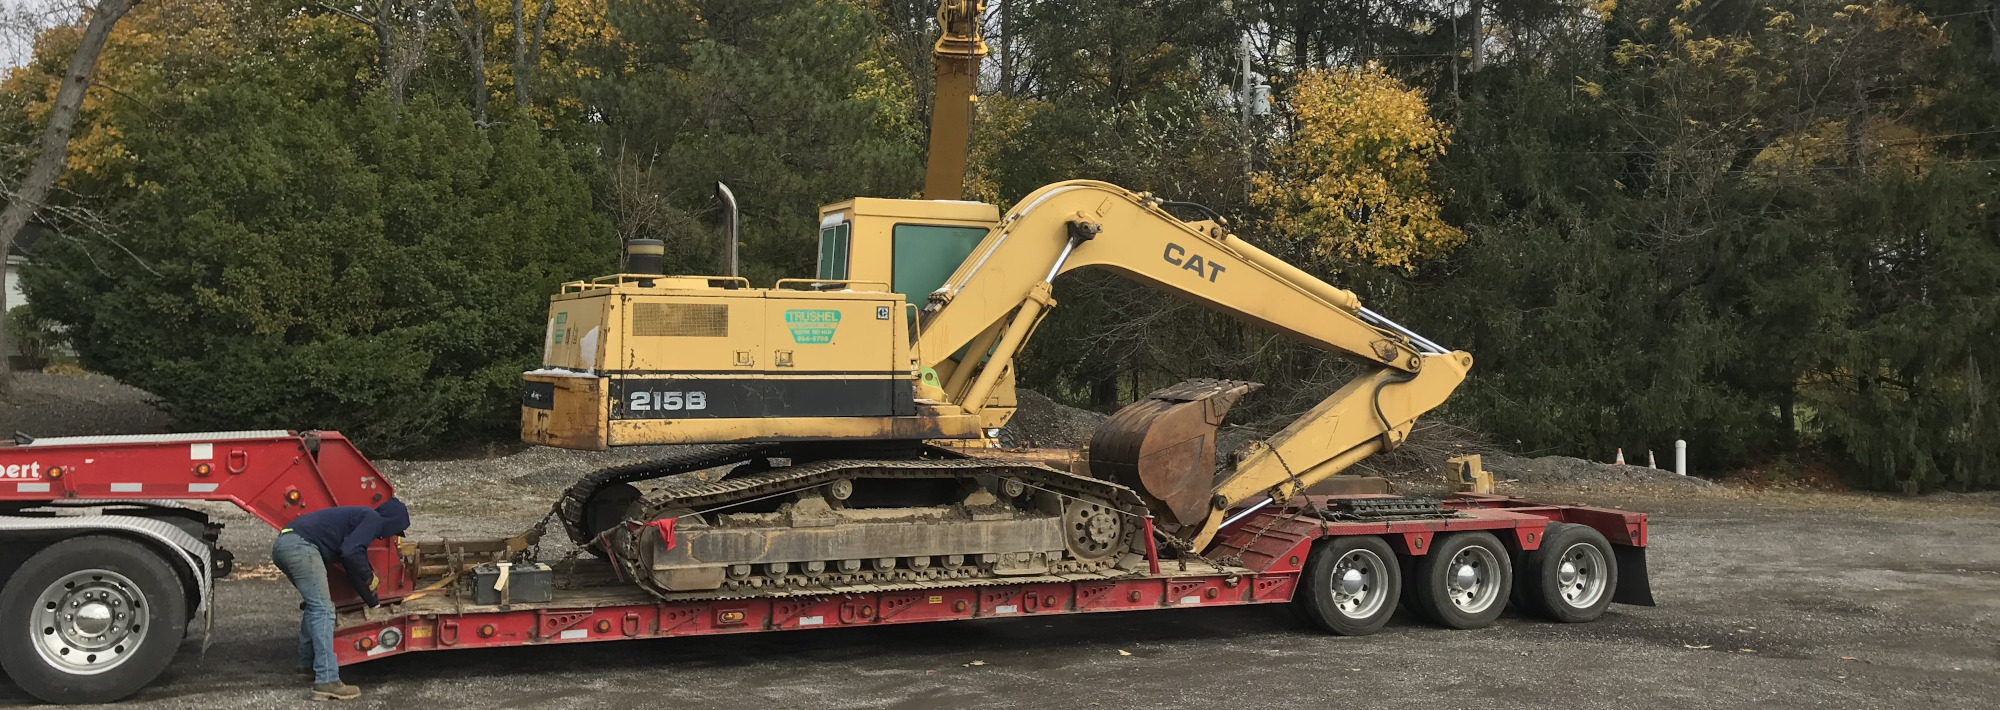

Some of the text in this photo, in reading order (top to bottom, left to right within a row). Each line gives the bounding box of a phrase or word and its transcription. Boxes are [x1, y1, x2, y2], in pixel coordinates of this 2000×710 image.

[1163, 242, 1226, 283] CAT
[788, 311, 839, 322] TRUSHEL
[630, 391, 707, 411] 215B
